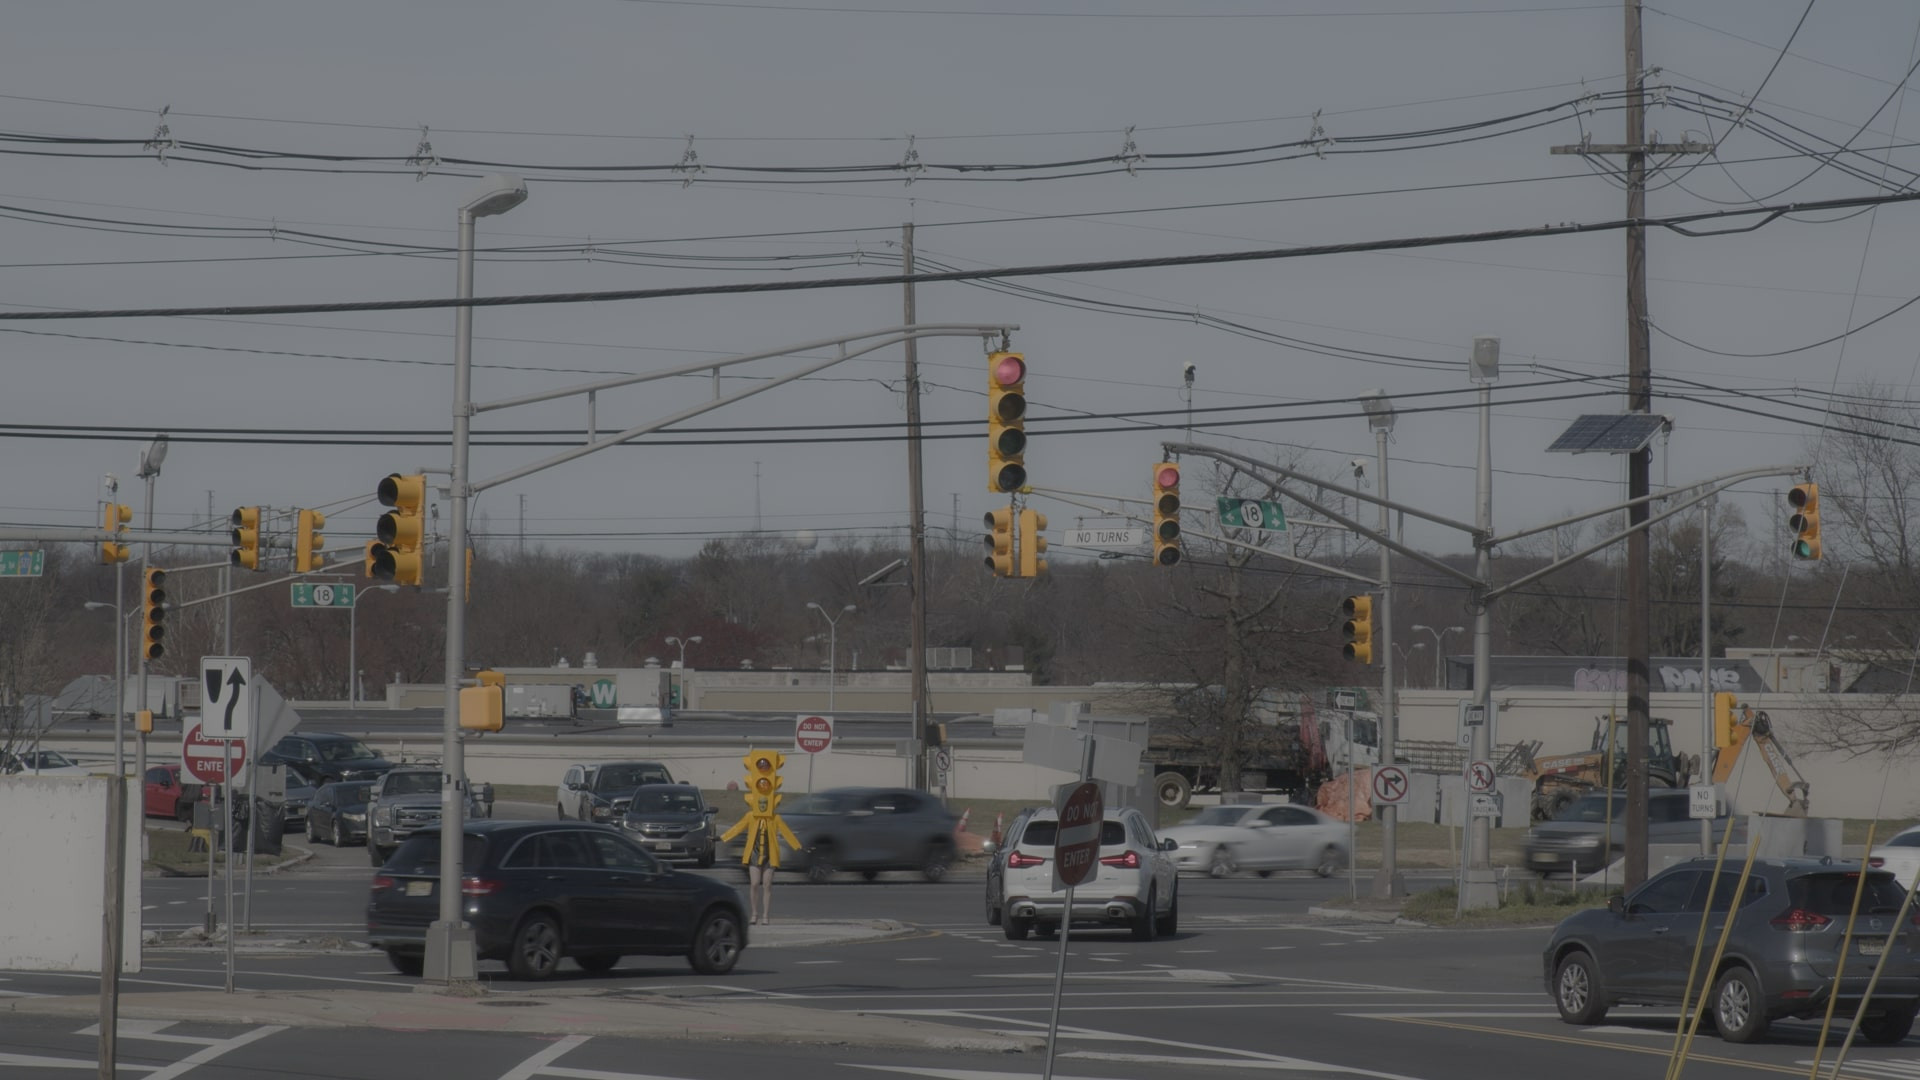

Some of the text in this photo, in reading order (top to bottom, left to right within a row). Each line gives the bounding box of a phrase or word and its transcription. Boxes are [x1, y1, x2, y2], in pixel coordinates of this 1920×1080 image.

[1245, 506, 1260, 522] 18
[1077, 531, 1129, 543] NO TURNS
[317, 590, 330, 602] 18
[592, 683, 617, 705] W
[196, 760, 225, 772] ENTE
[1543, 758, 1572, 769] CASE
[1697, 791, 1709, 801] NO
[1067, 801, 1100, 822] DO NOT
[1692, 803, 1714, 814] TURNS
[1064, 848, 1090, 868] ENTER
